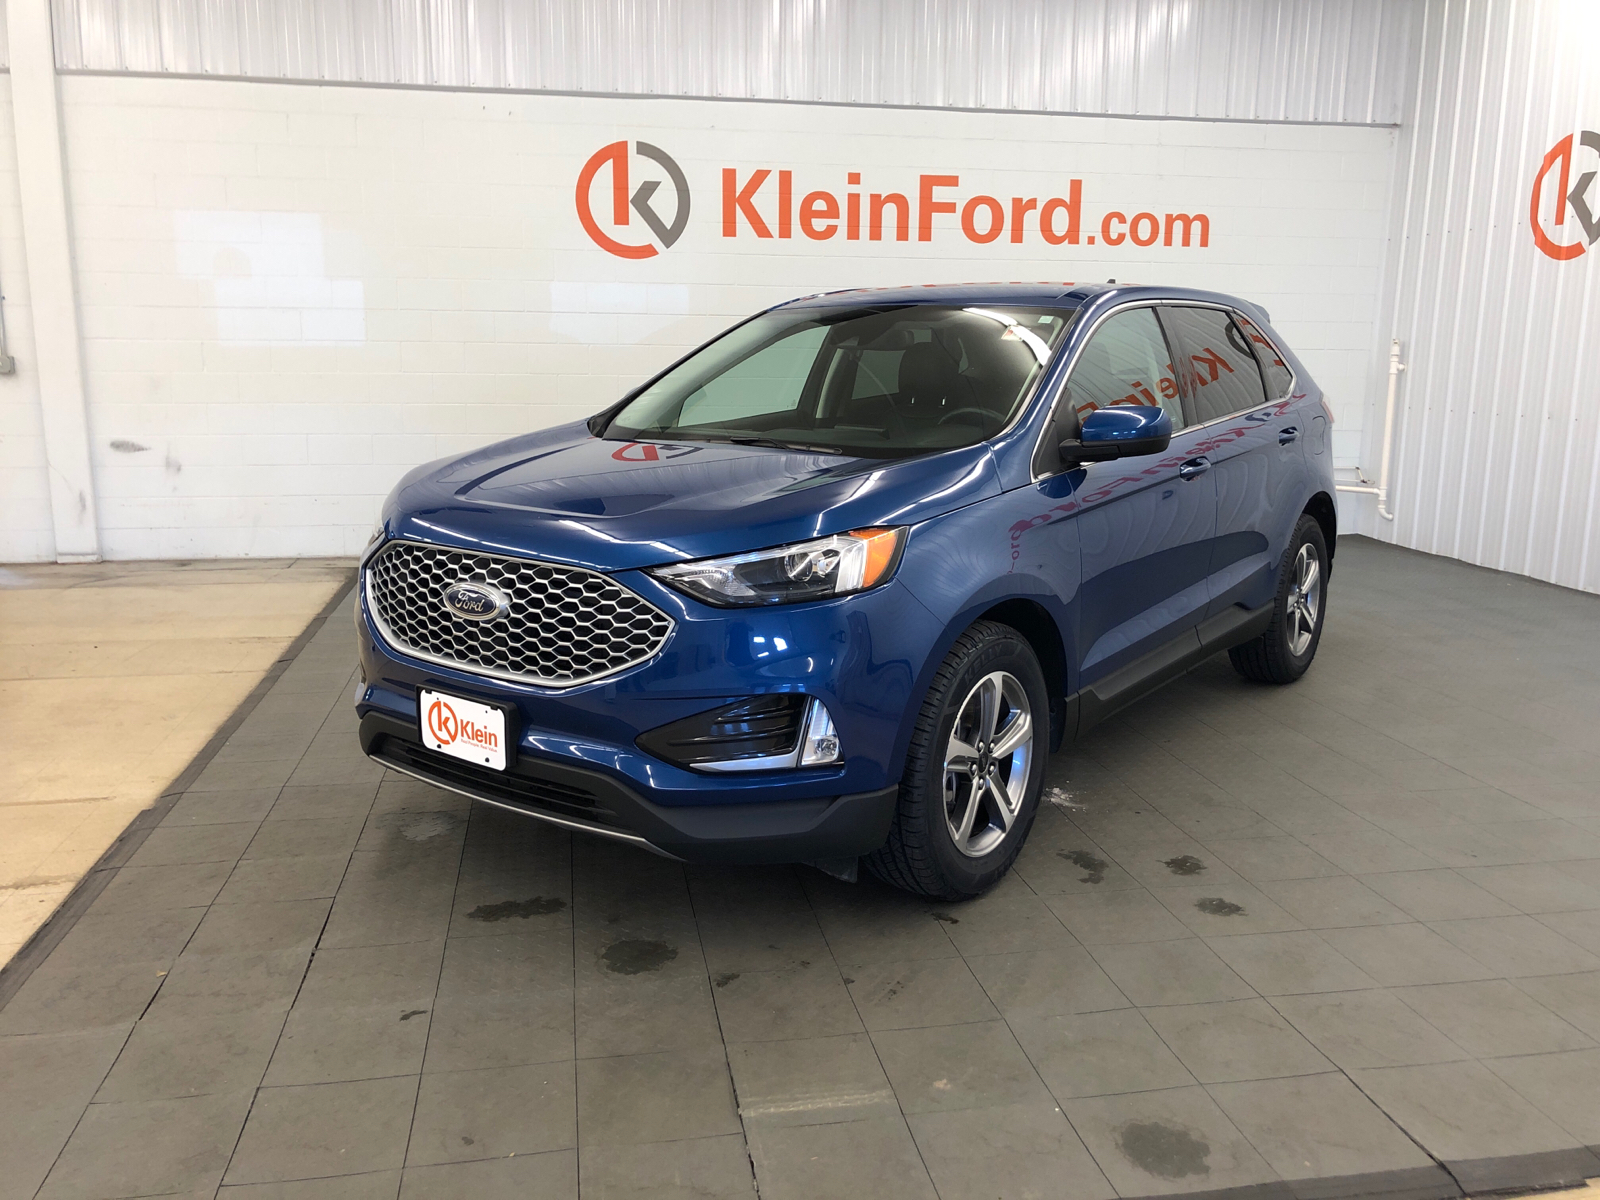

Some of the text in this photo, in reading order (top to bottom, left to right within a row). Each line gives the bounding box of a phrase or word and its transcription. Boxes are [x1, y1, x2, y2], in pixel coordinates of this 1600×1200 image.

[722, 168, 1209, 248] KleinFord.com
[455, 590, 487, 612] Ford
[964, 644, 1002, 685] KELLY
[460, 718, 498, 748] Klein
